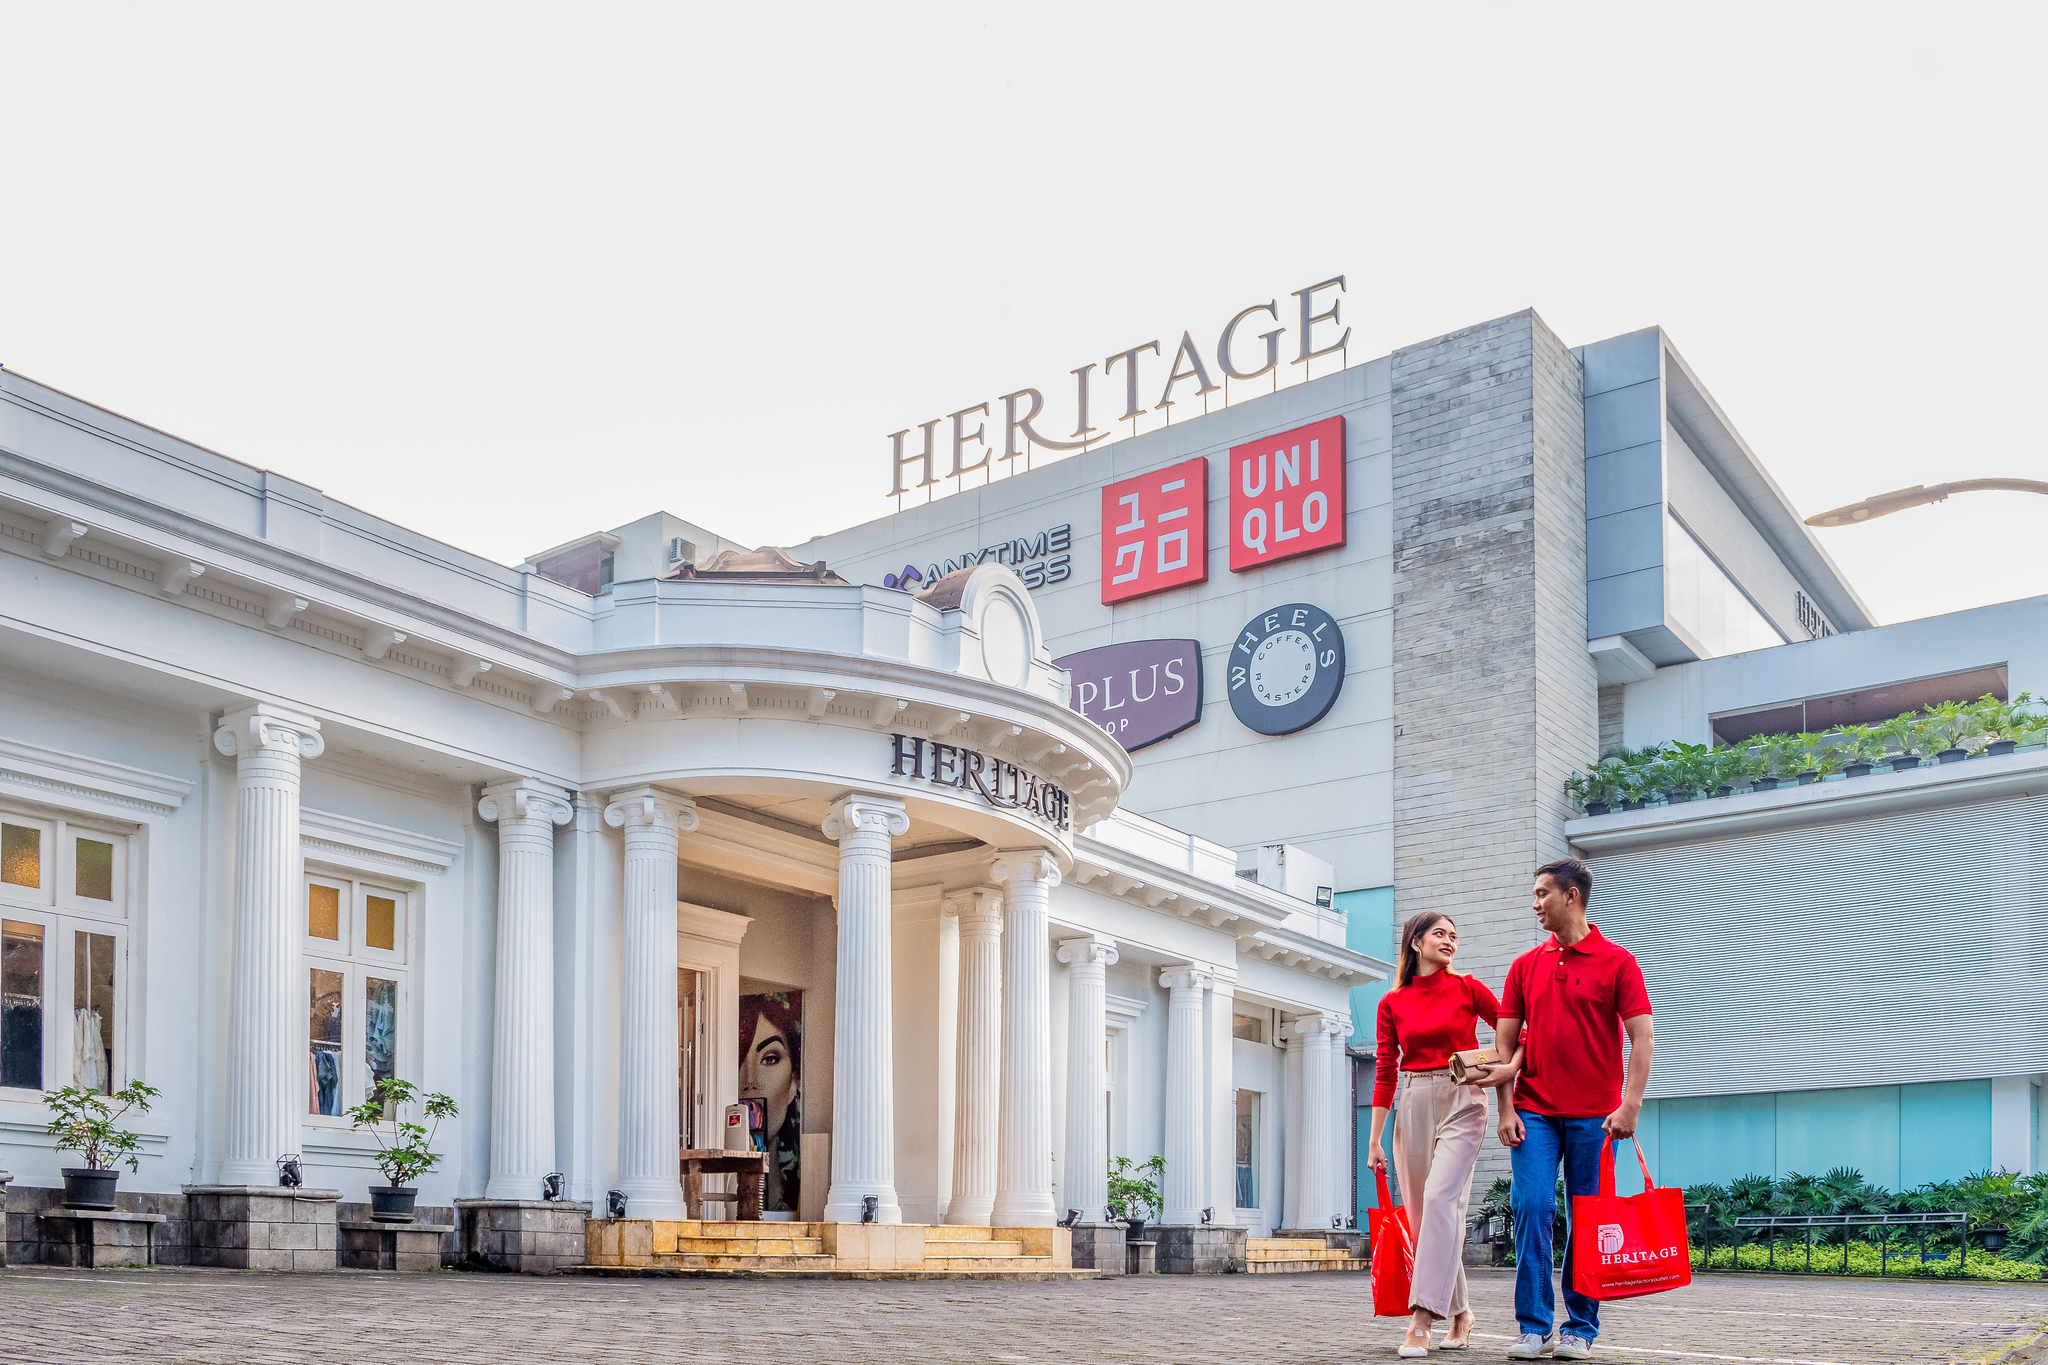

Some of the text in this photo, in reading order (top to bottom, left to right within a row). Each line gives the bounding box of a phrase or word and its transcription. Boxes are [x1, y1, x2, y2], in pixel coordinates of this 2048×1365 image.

[886, 275, 1351, 497] HERITAGE
[1242, 438, 1320, 499] UNI
[1242, 490, 1329, 555] QLO
[921, 523, 1071, 589] ANYTIME
[1231, 608, 1336, 691] WHEELS
[1258, 634, 1309, 661] COFFEE
[1076, 657, 1186, 716] PLUS
[1255, 662, 1312, 702] ROASTERS
[891, 733, 1070, 832] HERITAGE
[1601, 1246, 1678, 1264] HERITAGE
